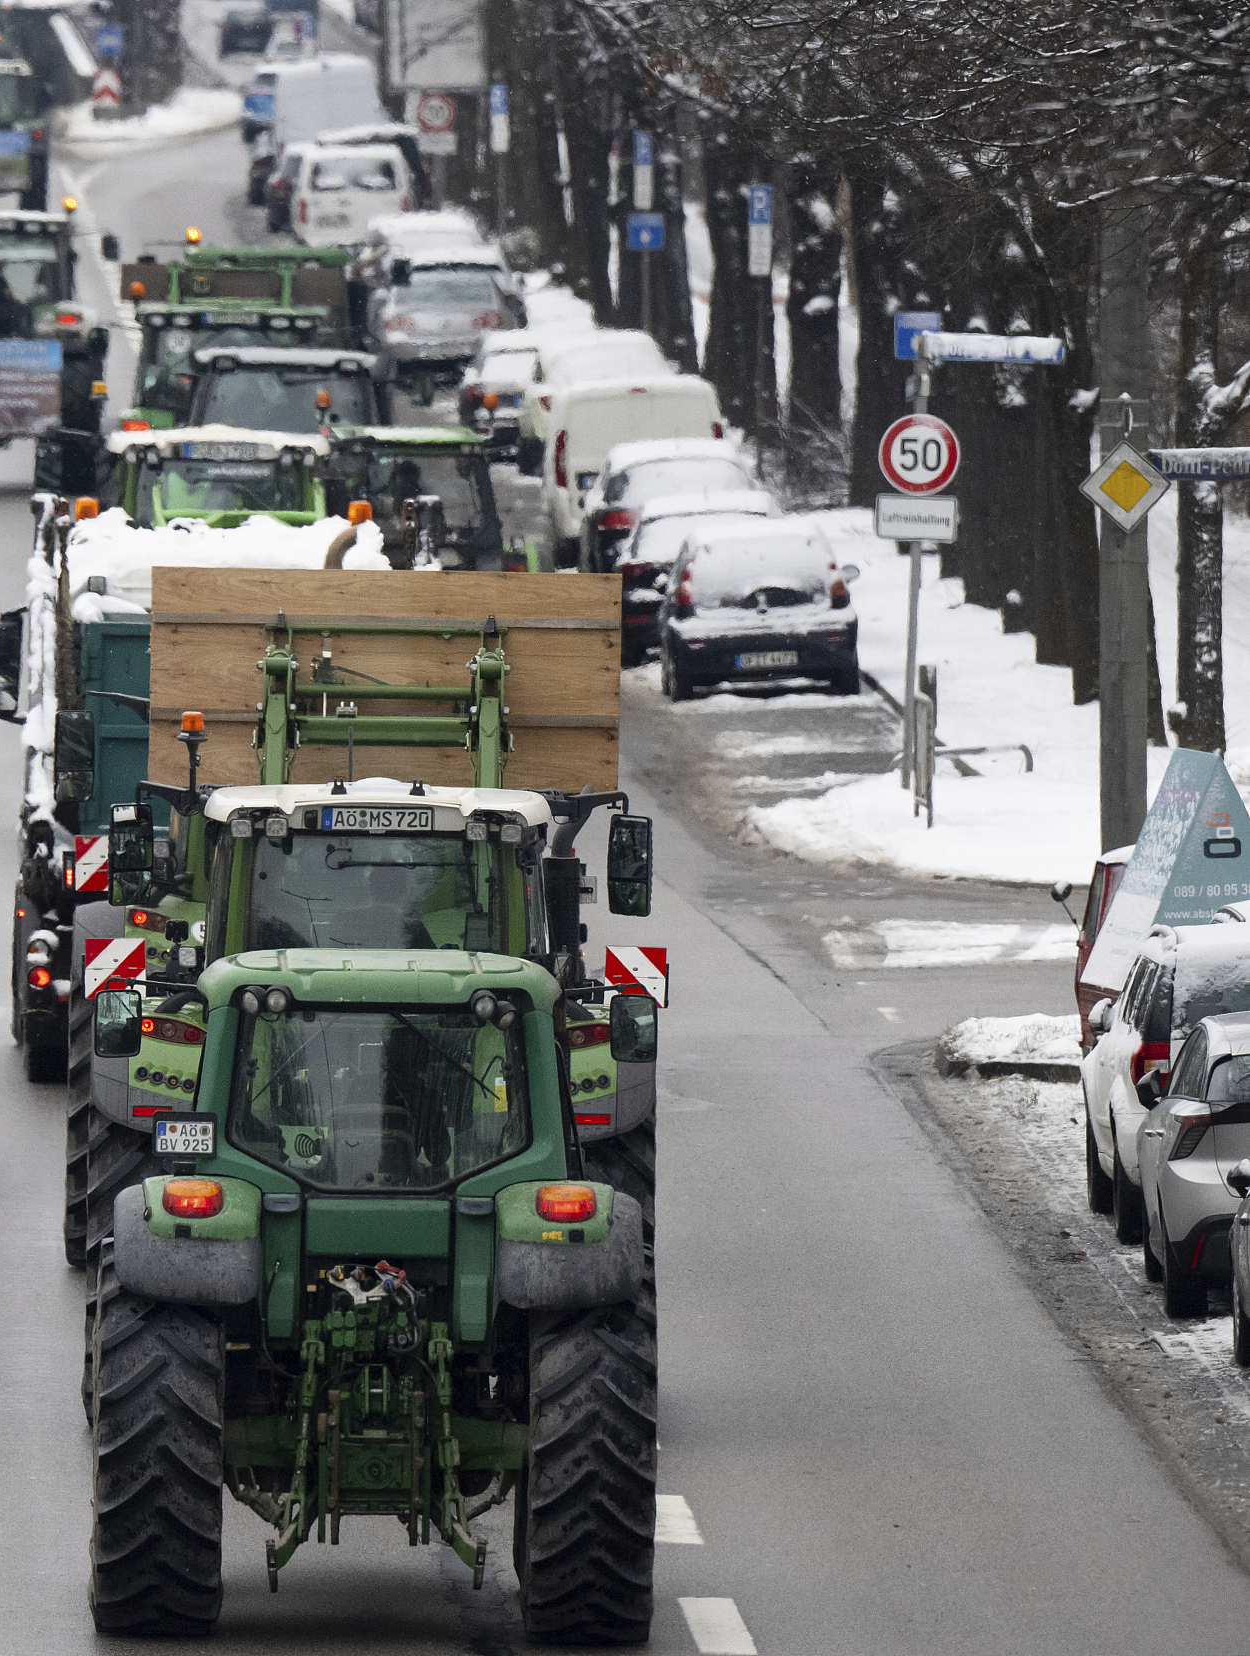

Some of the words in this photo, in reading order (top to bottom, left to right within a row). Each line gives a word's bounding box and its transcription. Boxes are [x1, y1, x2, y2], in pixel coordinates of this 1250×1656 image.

[899, 438, 941, 471] 50
[882, 513, 950, 526] Luftreinhaltung
[334, 810, 357, 827] AÖ
[370, 810, 392, 828] MS
[396, 811, 429, 828] 720
[1173, 885, 1195, 897] 089
[1206, 884, 1221, 897] 80
[1224, 883, 1238, 896] 95
[1164, 908, 1216, 919] www.abst
[180, 1124, 198, 1137] AÖ
[160, 1138, 178, 1151] BV
[182, 1138, 209, 1151] 925
